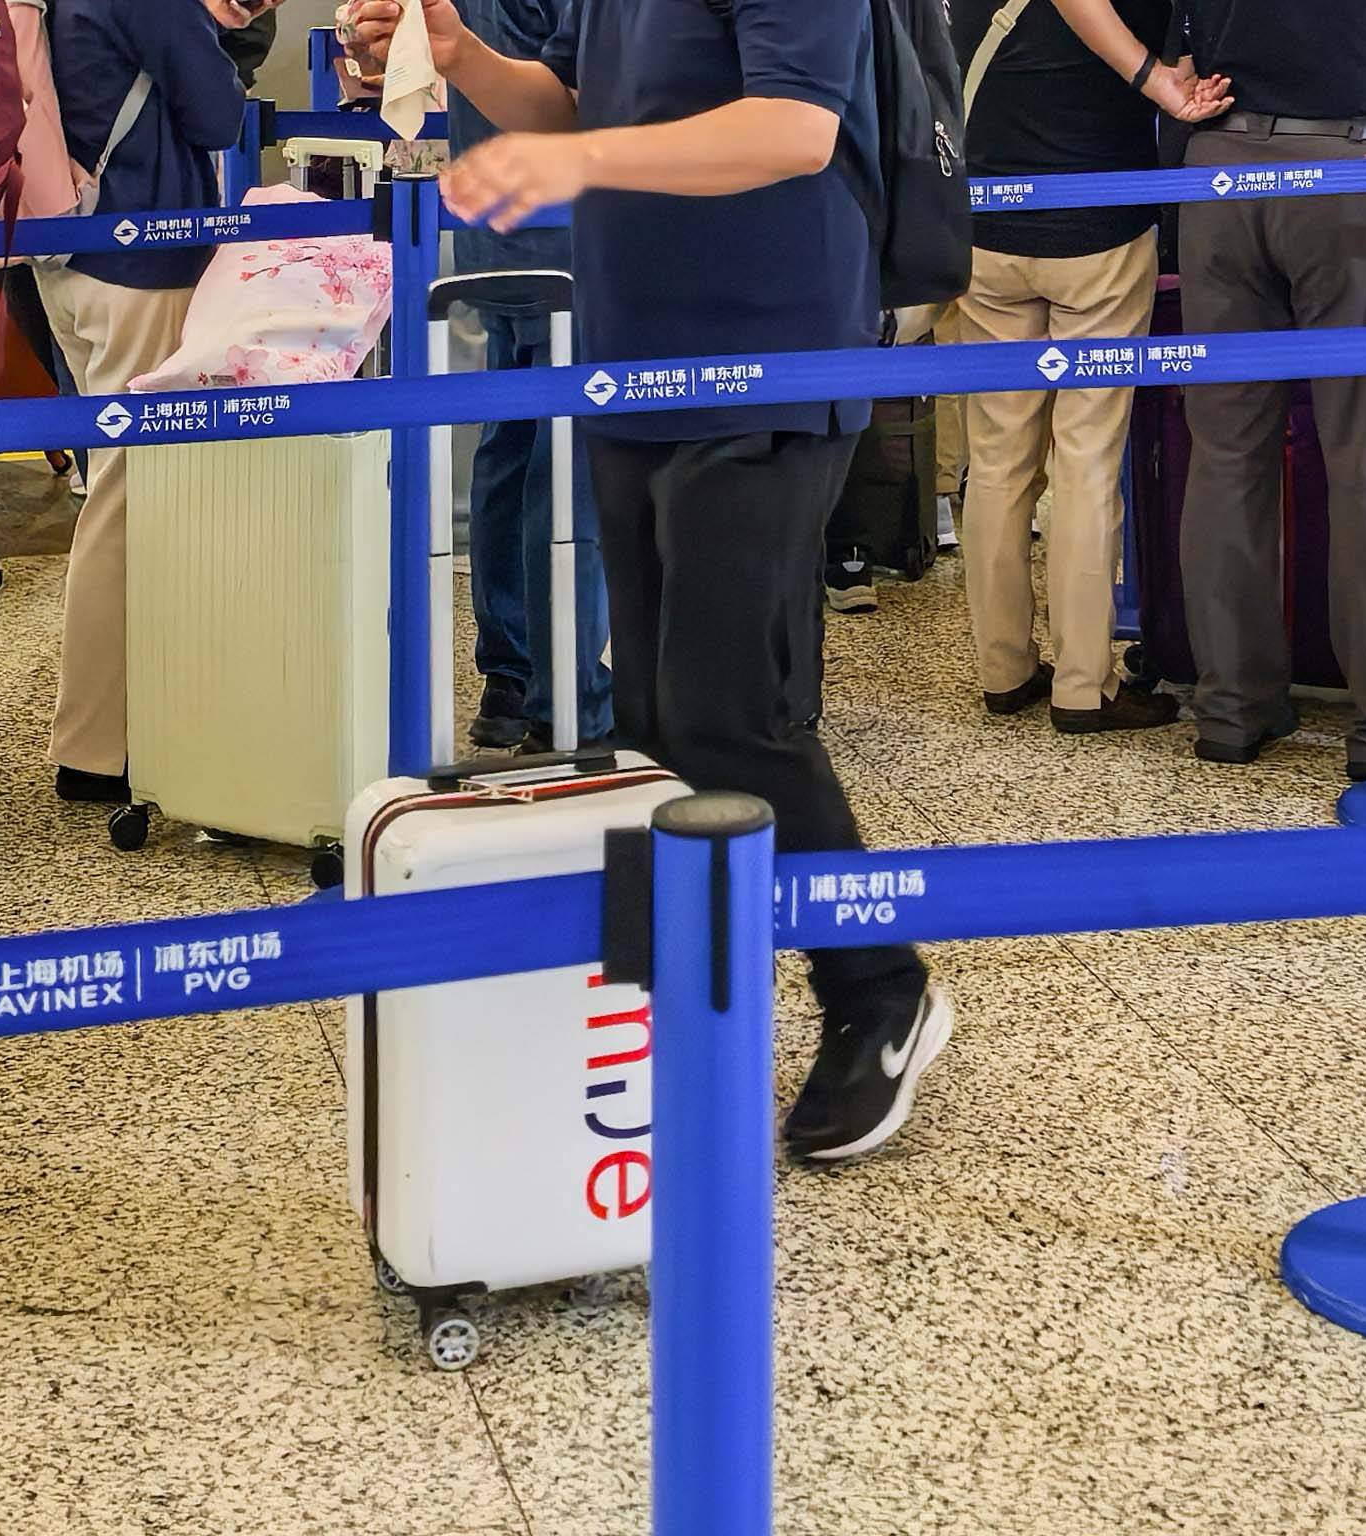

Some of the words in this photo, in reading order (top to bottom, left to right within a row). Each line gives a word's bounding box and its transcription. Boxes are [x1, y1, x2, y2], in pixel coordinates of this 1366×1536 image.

[1236, 182, 1276, 192] AVINEX
[1293, 180, 1314, 189] PVG
[1002, 195, 1024, 205] PVG
[143, 218, 192, 232] 上海机场
[203, 214, 251, 228] 浦东机场
[143, 229, 192, 242] AVINEX
[214, 226, 240, 237] PVG
[1075, 347, 1134, 364] 上海机场
[1147, 344, 1207, 361] 浦东机场
[624, 369, 687, 387] 上海机场
[701, 365, 764, 381] 浦东机场
[1075, 362, 1134, 377] AVINEX
[1161, 359, 1193, 373] PVG
[624, 385, 686, 400] AVINEX
[716, 380, 749, 394] PVG
[139, 400, 208, 420] 上海机场
[223, 395, 291, 415] 浦东机场
[139, 416, 207, 433] AVINEX
[239, 412, 275, 427] PVG
[809, 869, 925, 902] 浦东机场
[836, 902, 896, 925] PVG
[155, 932, 282, 973] 浦东机场
[185, 968, 251, 995] PVG
